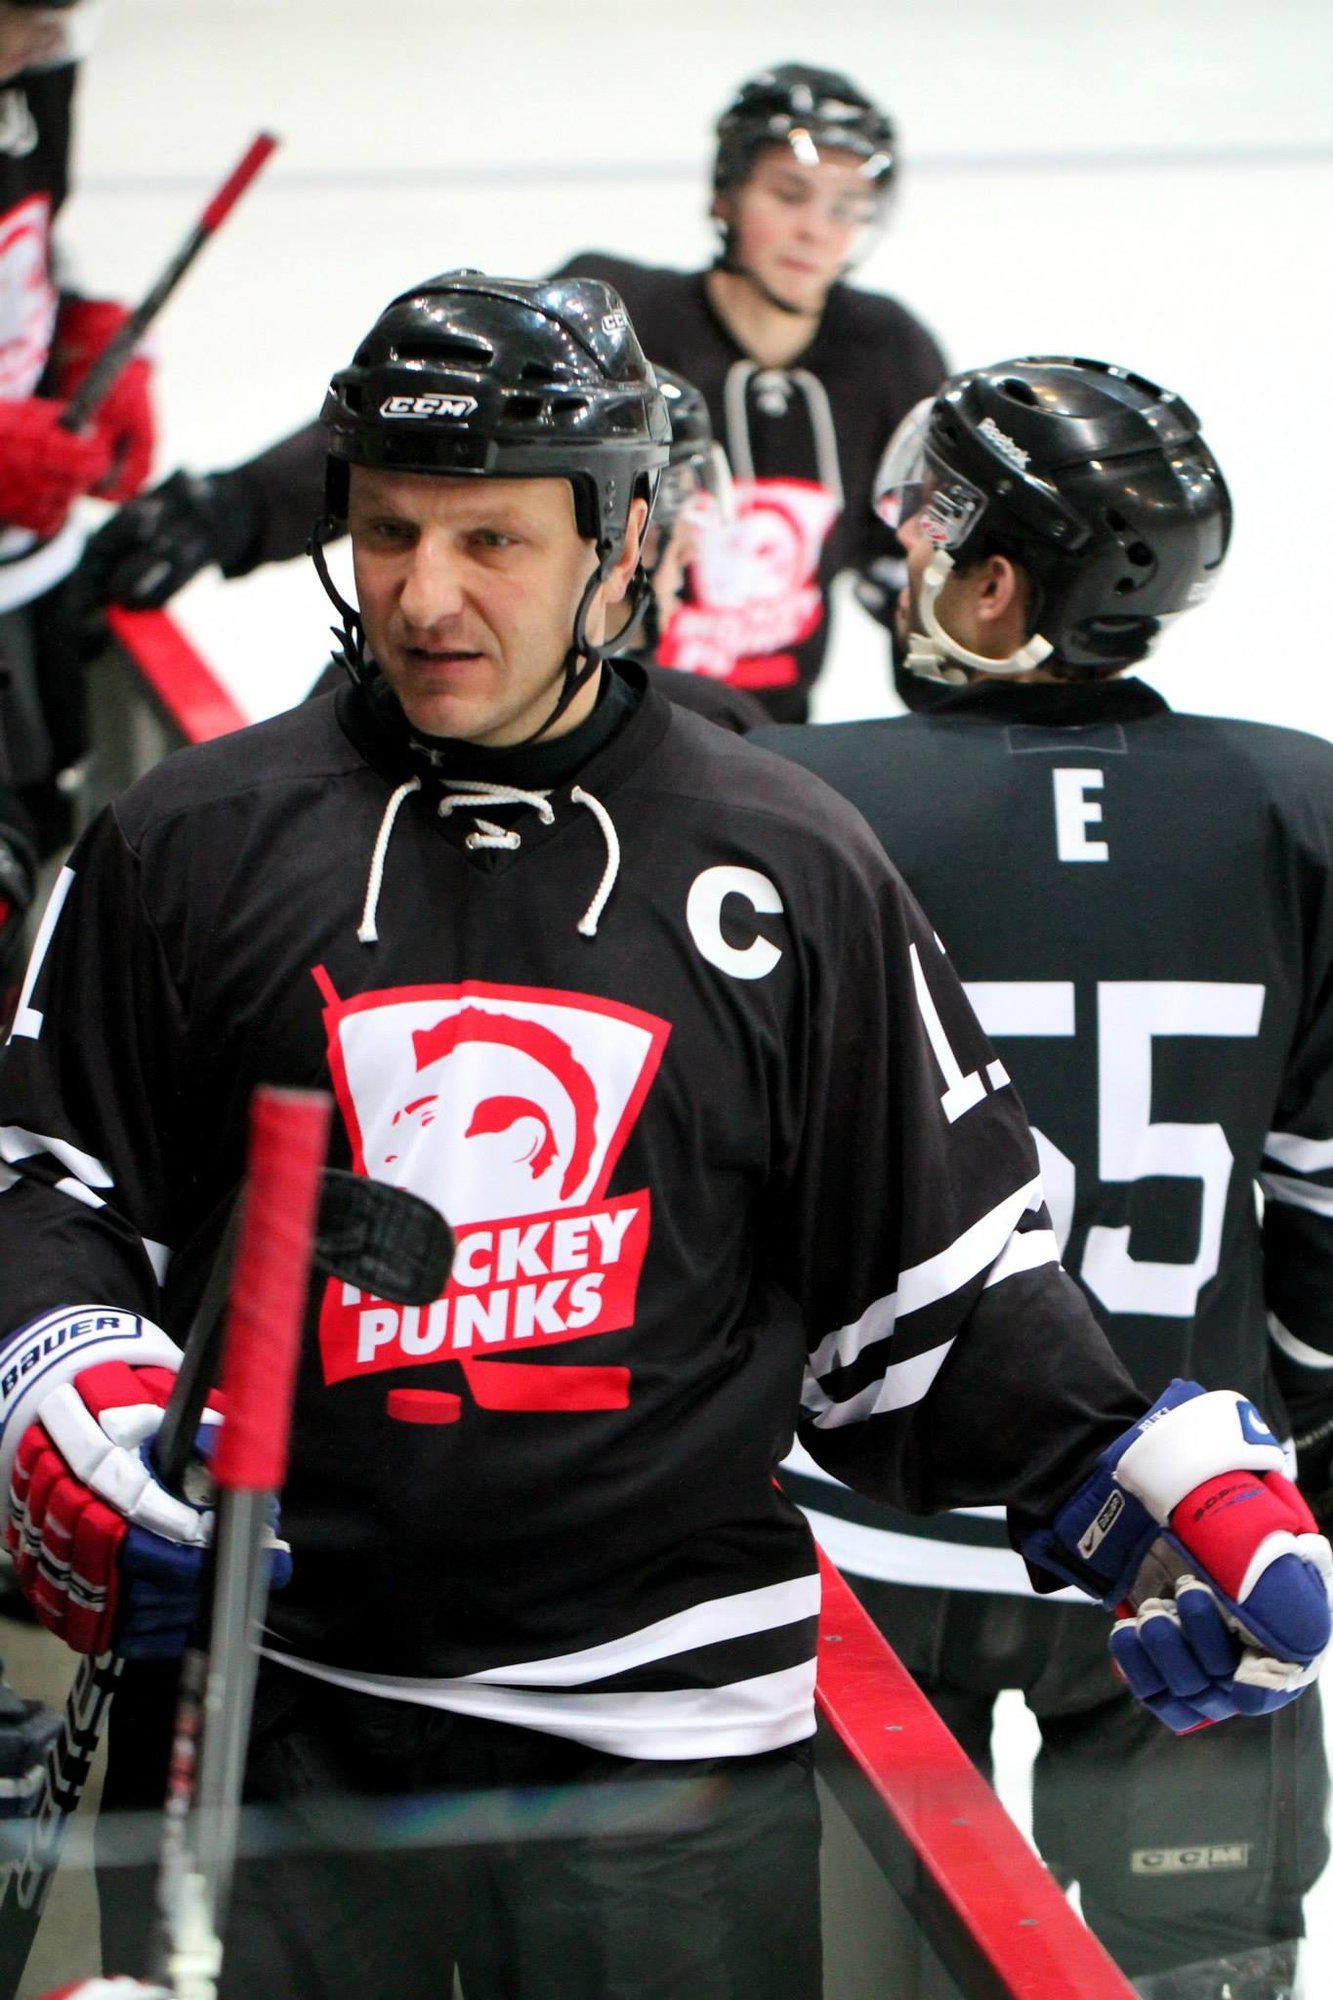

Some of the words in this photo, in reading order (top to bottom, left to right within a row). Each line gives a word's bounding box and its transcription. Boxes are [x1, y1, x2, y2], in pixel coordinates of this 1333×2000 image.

[386, 396, 471, 417] CCM
[1053, 768, 1109, 862] E
[687, 866, 784, 980] C
[341, 1208, 639, 1306] CKEY
[357, 1273, 605, 1363] PUNKS
